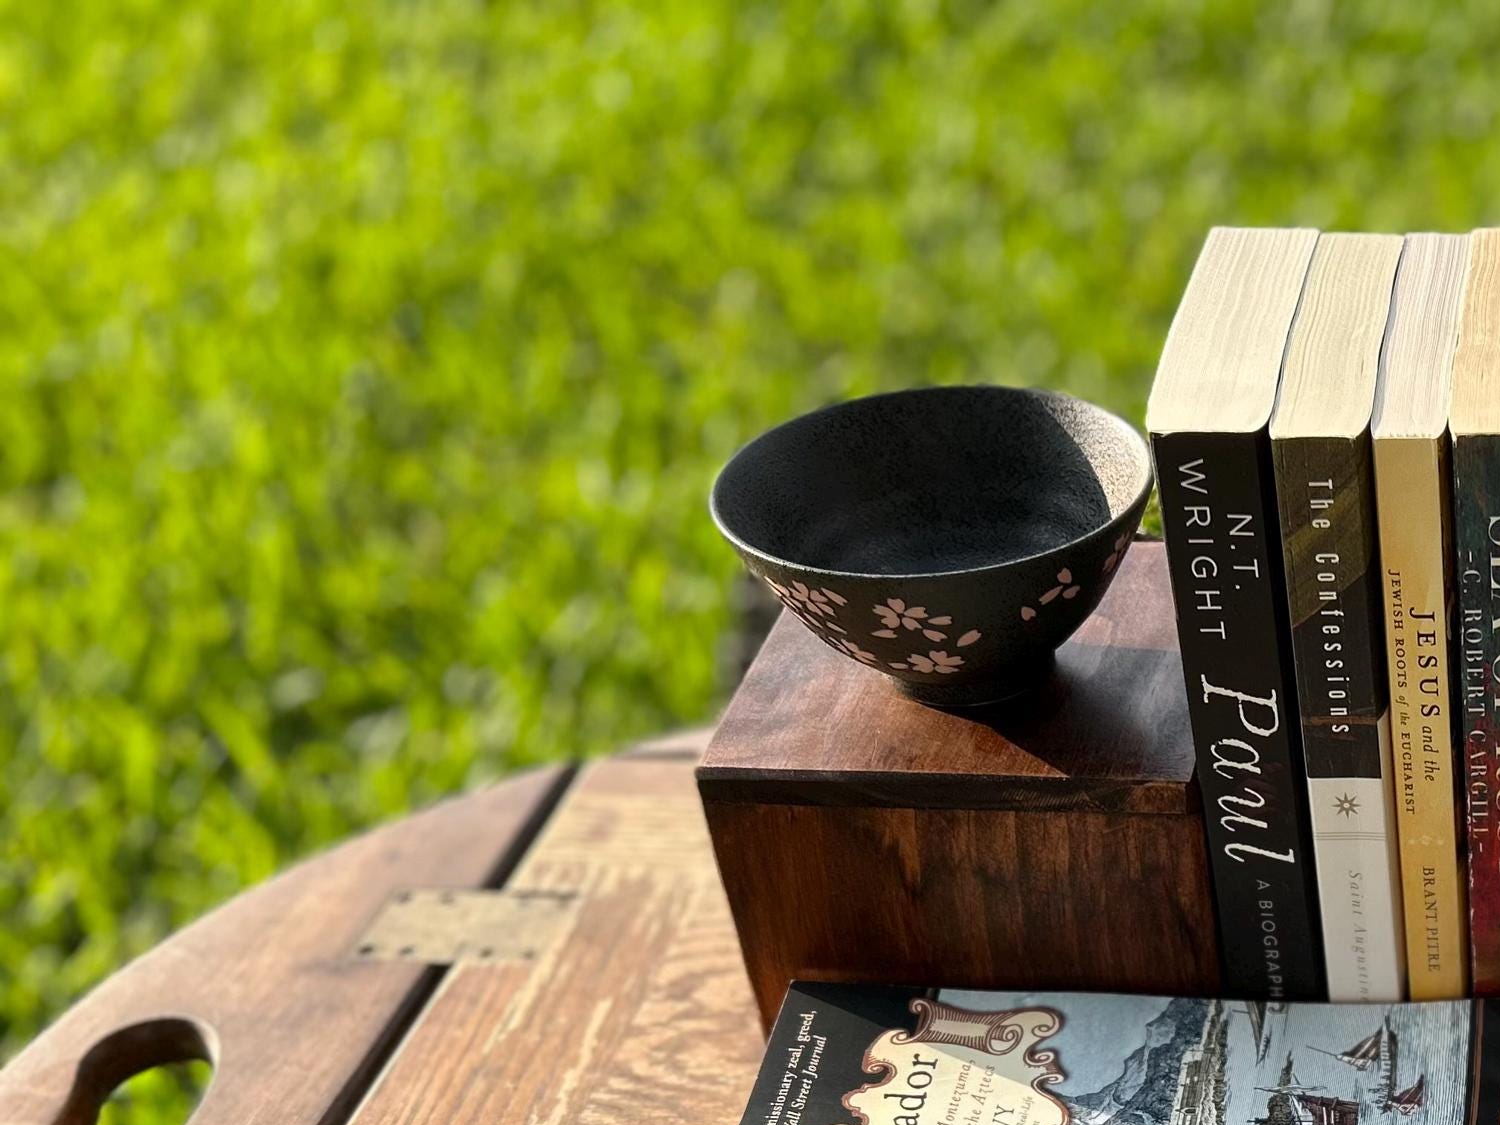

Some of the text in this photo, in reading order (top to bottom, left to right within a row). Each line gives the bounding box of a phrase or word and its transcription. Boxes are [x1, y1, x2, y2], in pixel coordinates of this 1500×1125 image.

[1178, 458, 1226, 640] WRIGHT
[1308, 478, 1350, 734] The Confessions
[1388, 568, 1416, 815] JEWISH ROOTS of the EUCHARIST
[1409, 606, 1441, 782] JESUS and the
[1464, 608, 1486, 717] ROBERT
[1200, 673, 1296, 864] Paul
[1255, 879, 1284, 998] A BIOGRAPH
[1348, 869, 1366, 916] Saint
[1422, 865, 1442, 973] BRANT PITRE
[787, 1045, 806, 1069] zeal,
[797, 1010, 818, 1043] greed,
[791, 1077, 813, 1111] Street
[802, 1034, 828, 1080] Journal
[970, 1064, 996, 1107] Aztecs
